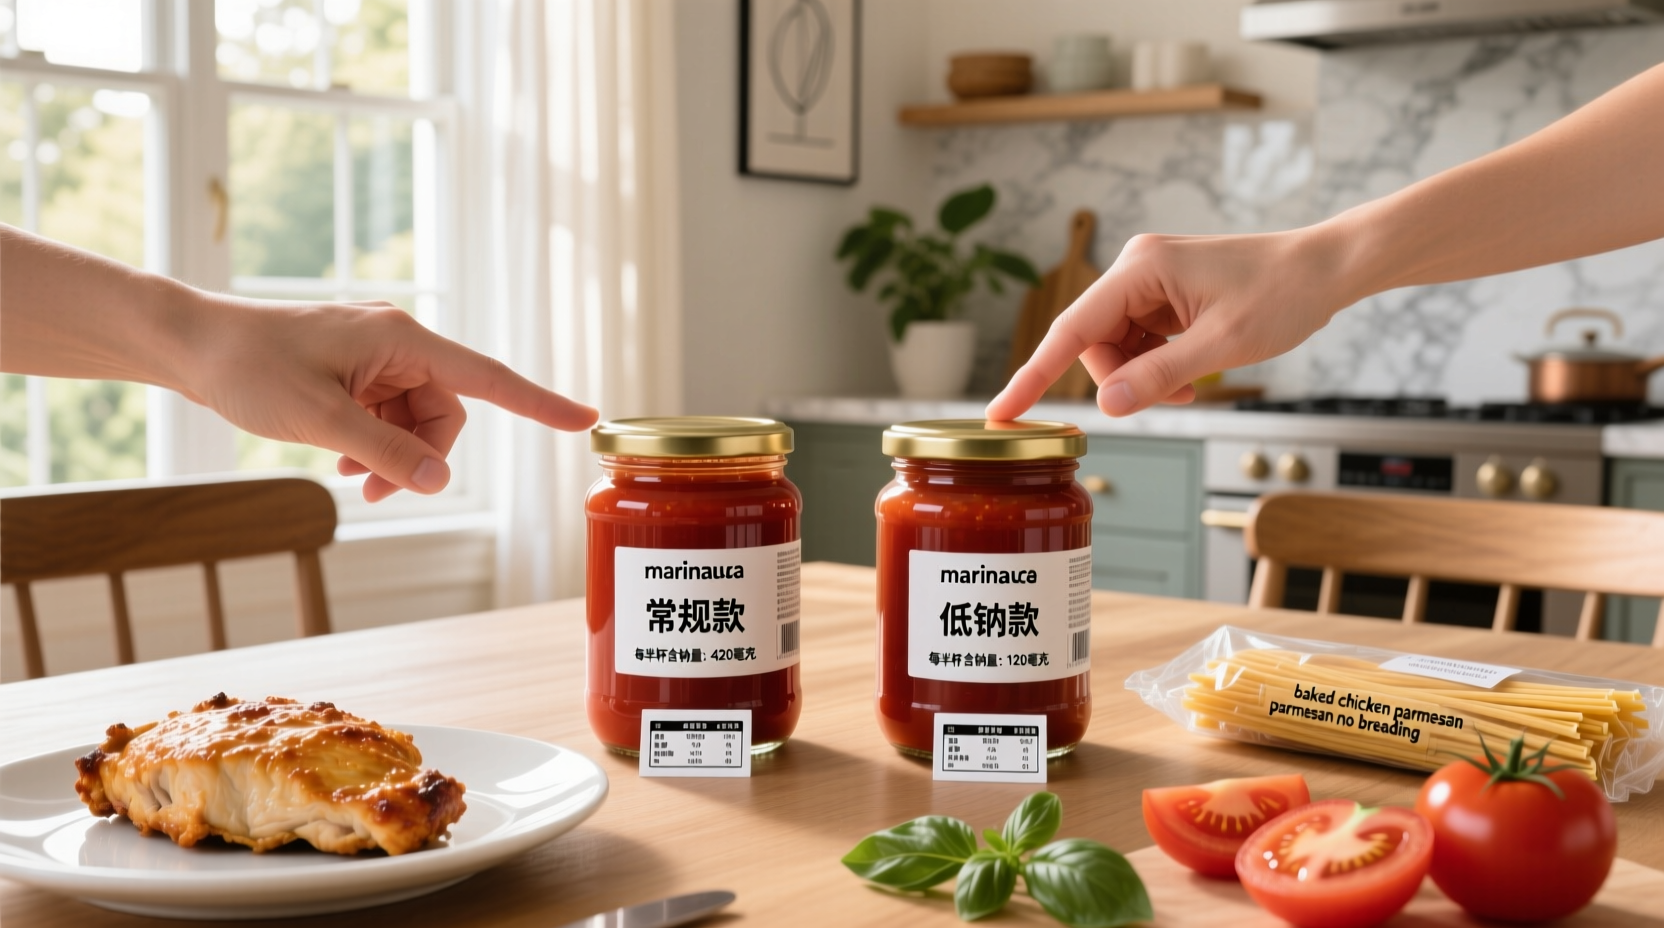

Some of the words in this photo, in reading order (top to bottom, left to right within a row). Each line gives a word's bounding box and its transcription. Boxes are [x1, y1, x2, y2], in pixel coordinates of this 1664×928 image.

[646, 598, 745, 634] 常规款
[940, 602, 1039, 637] 低钠款
[1269, 701, 1333, 723] parmesan
[1337, 713, 1354, 727] no
[1358, 714, 1421, 744] breading
[1294, 684, 1336, 705] baked
[1338, 693, 1391, 716] chicken
[1393, 706, 1464, 730] parmesan
